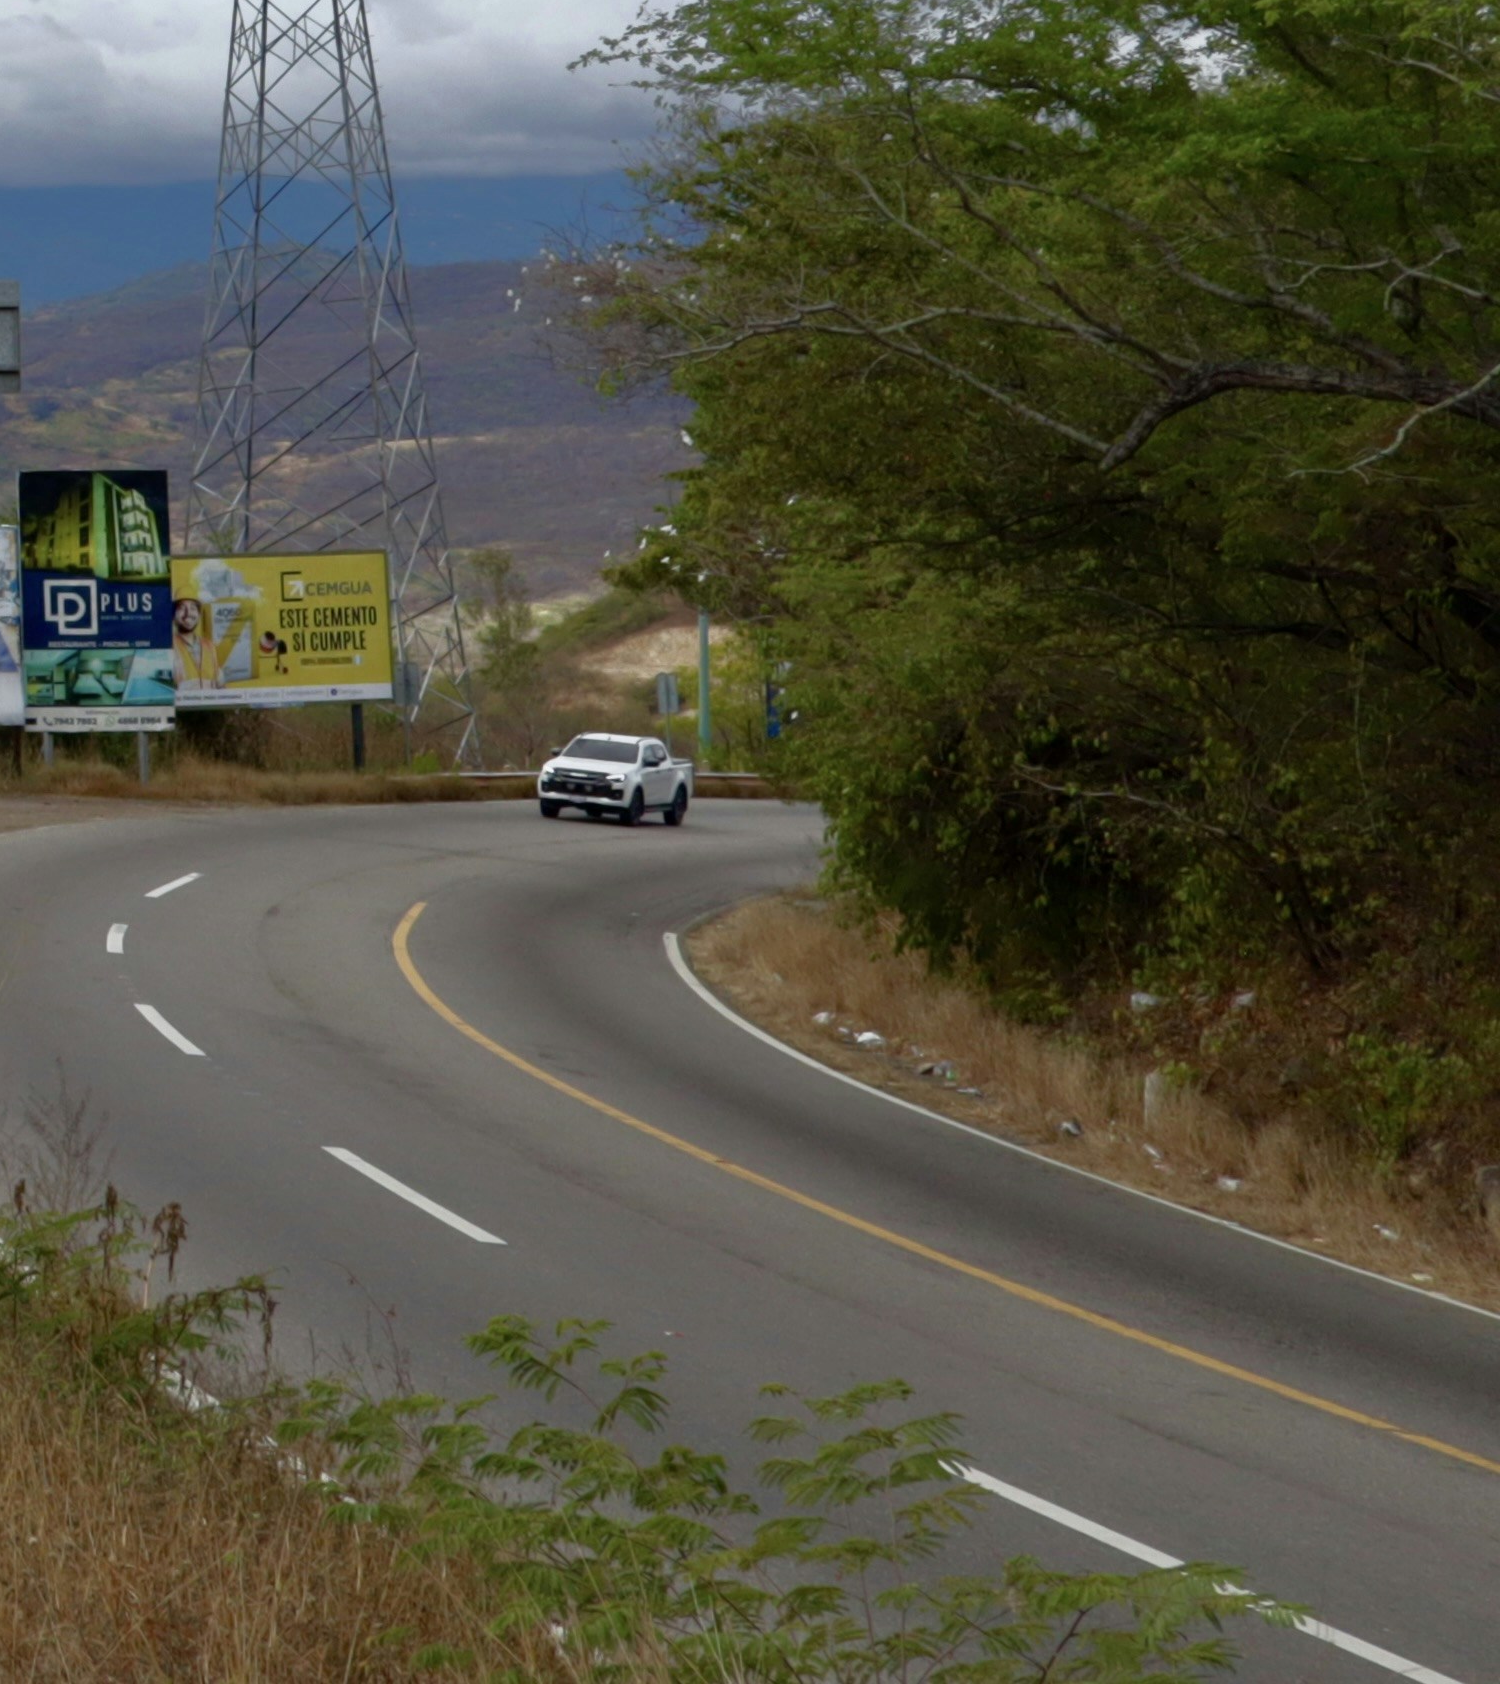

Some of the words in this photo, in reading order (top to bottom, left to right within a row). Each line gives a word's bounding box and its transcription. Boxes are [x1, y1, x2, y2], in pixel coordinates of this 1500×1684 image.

[305, 581, 372, 596] CEMGUA
[100, 592, 153, 613] PLUS
[279, 608, 308, 629] ESTE
[313, 606, 377, 627] CEMENTO
[310, 630, 366, 651] CUMPLE
